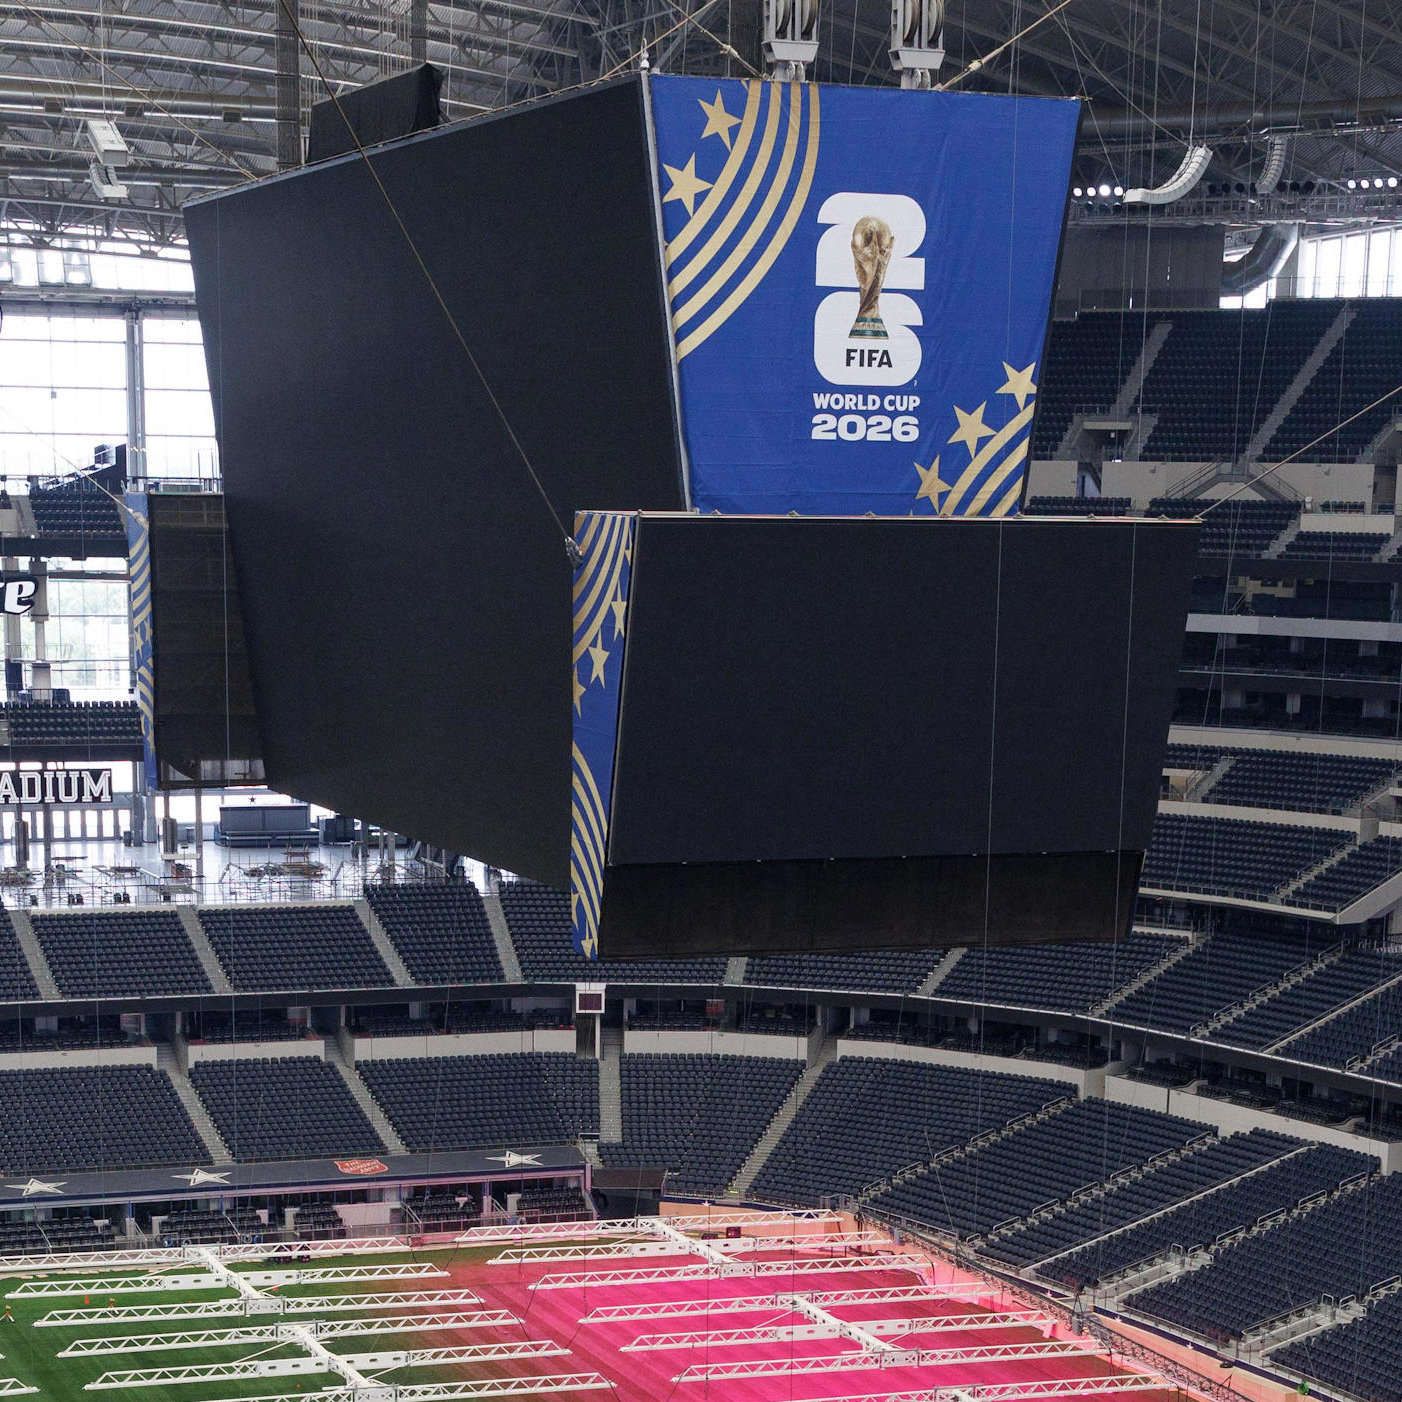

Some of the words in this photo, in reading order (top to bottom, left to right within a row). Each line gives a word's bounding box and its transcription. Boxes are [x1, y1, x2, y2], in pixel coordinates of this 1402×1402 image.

[845, 348, 893, 368] FIFA
[812, 393, 881, 411] WORLD
[883, 395, 921, 411] CUP
[811, 413, 920, 442] 2026
